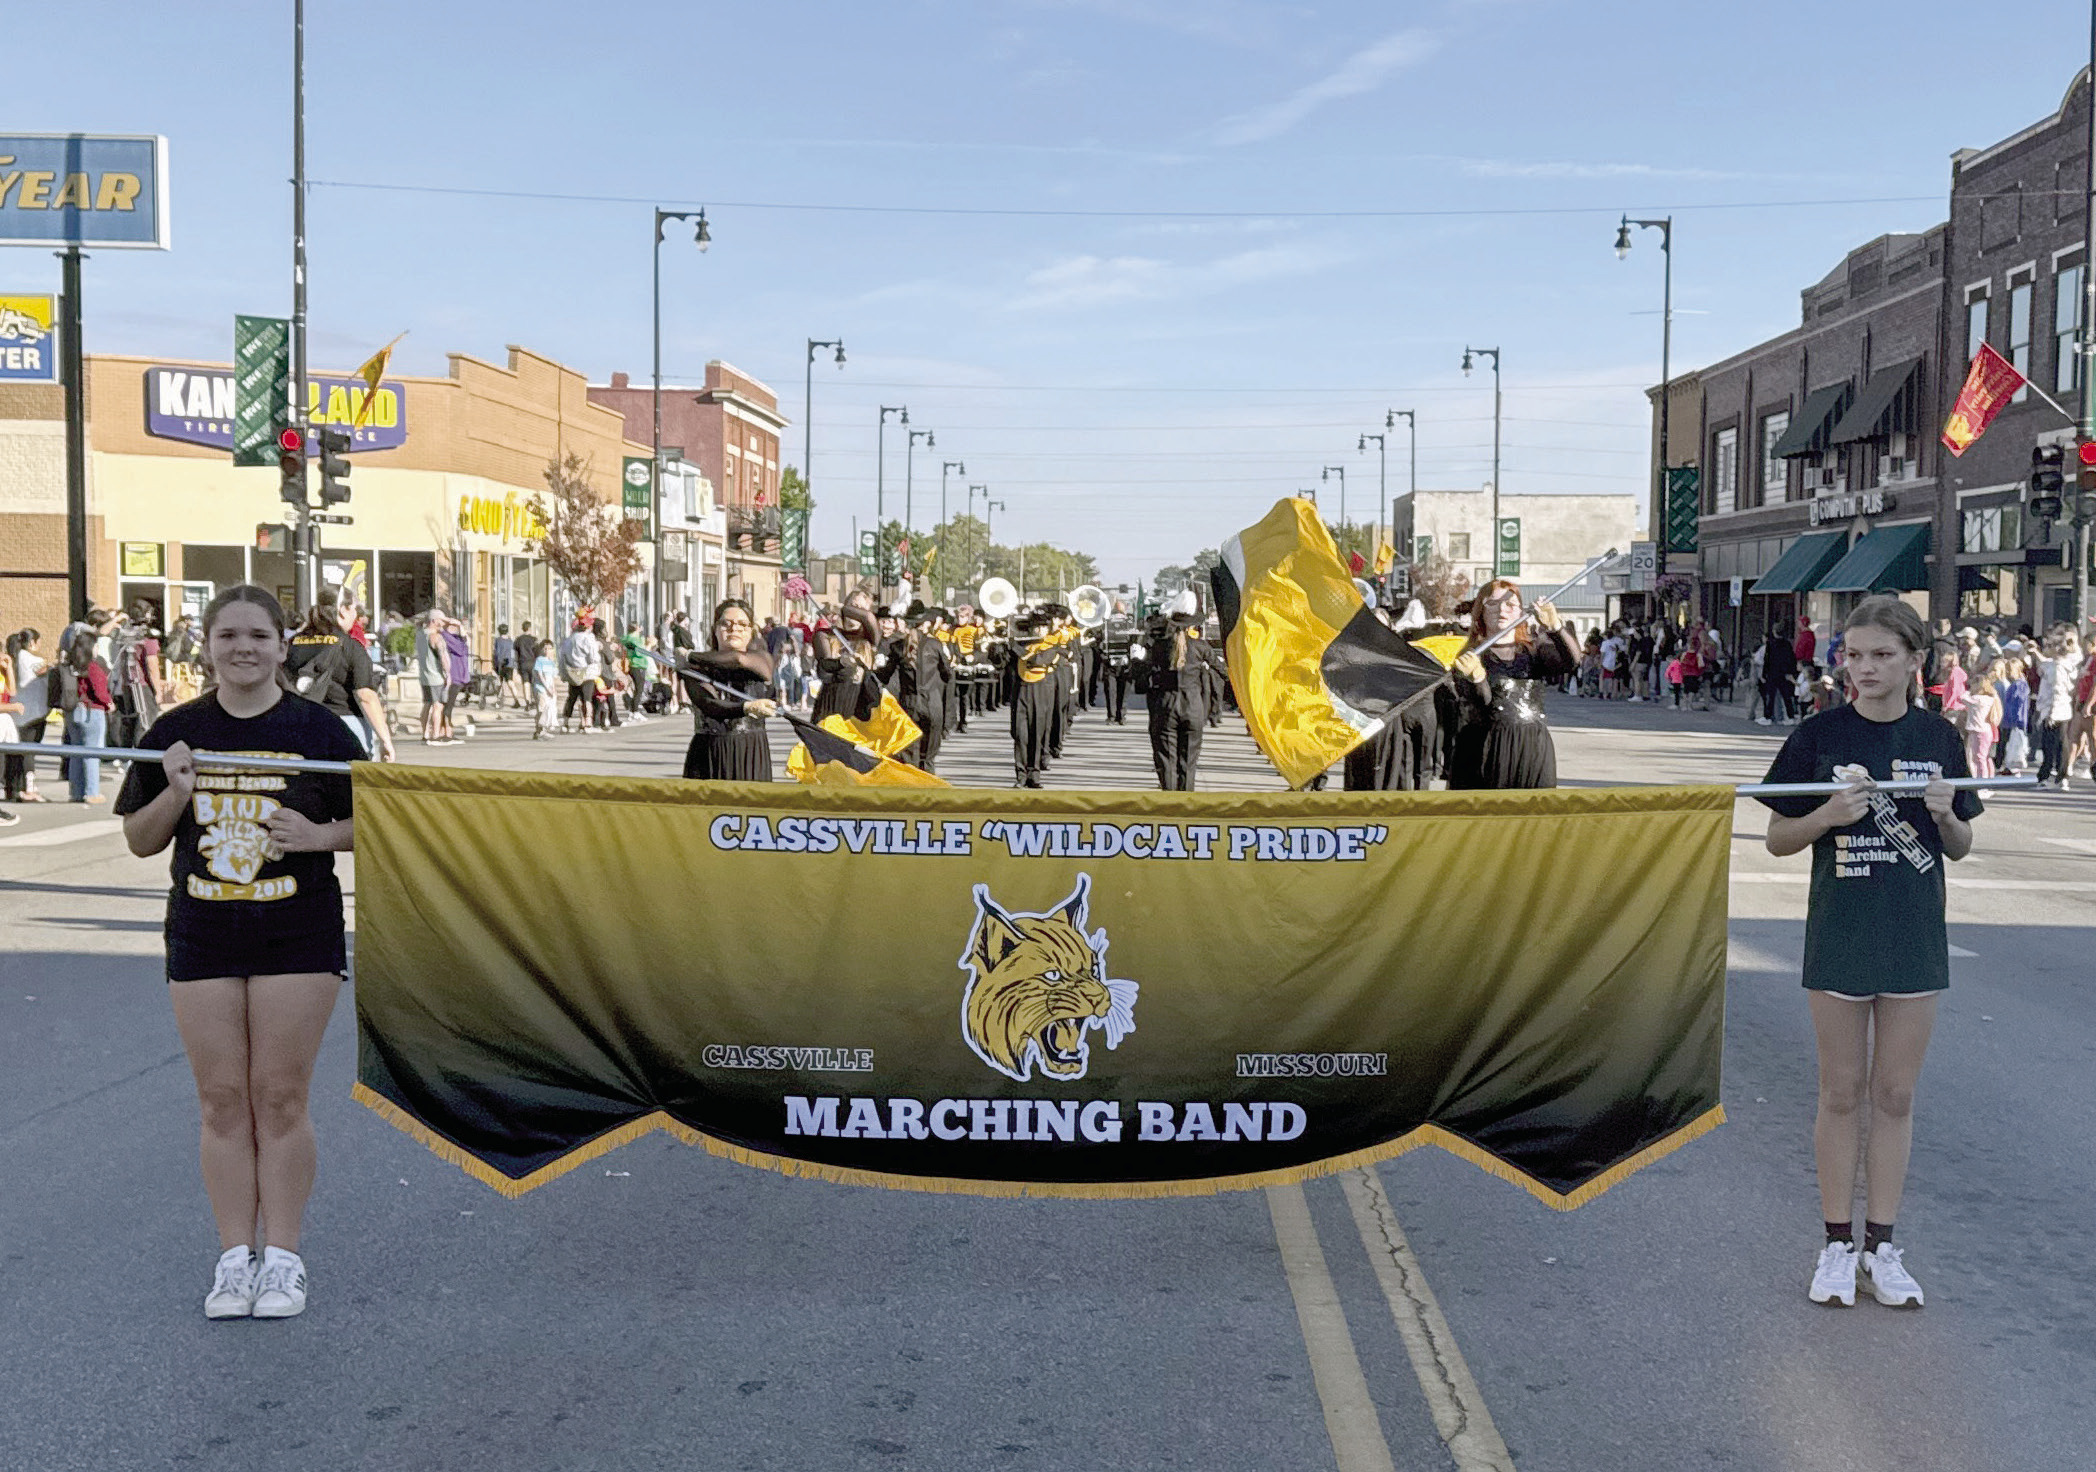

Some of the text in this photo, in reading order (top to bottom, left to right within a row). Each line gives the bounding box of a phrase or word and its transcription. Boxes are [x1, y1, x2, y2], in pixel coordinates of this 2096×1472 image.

[184, 421, 232, 435] TIRE
[460, 495, 546, 541] GOODYE
[1634, 557, 1654, 569] 20
[194, 793, 279, 823] BAND
[709, 814, 973, 856] CASSVILLE
[1835, 835, 1887, 849] Wildcat
[1835, 849, 1899, 864] Marching
[1836, 864, 1871, 879] Band
[702, 1044, 874, 1072] CASSVILLE
[1236, 1053, 1388, 1077] MISSOURI
[783, 1095, 1307, 1143] MARCHING BAND
